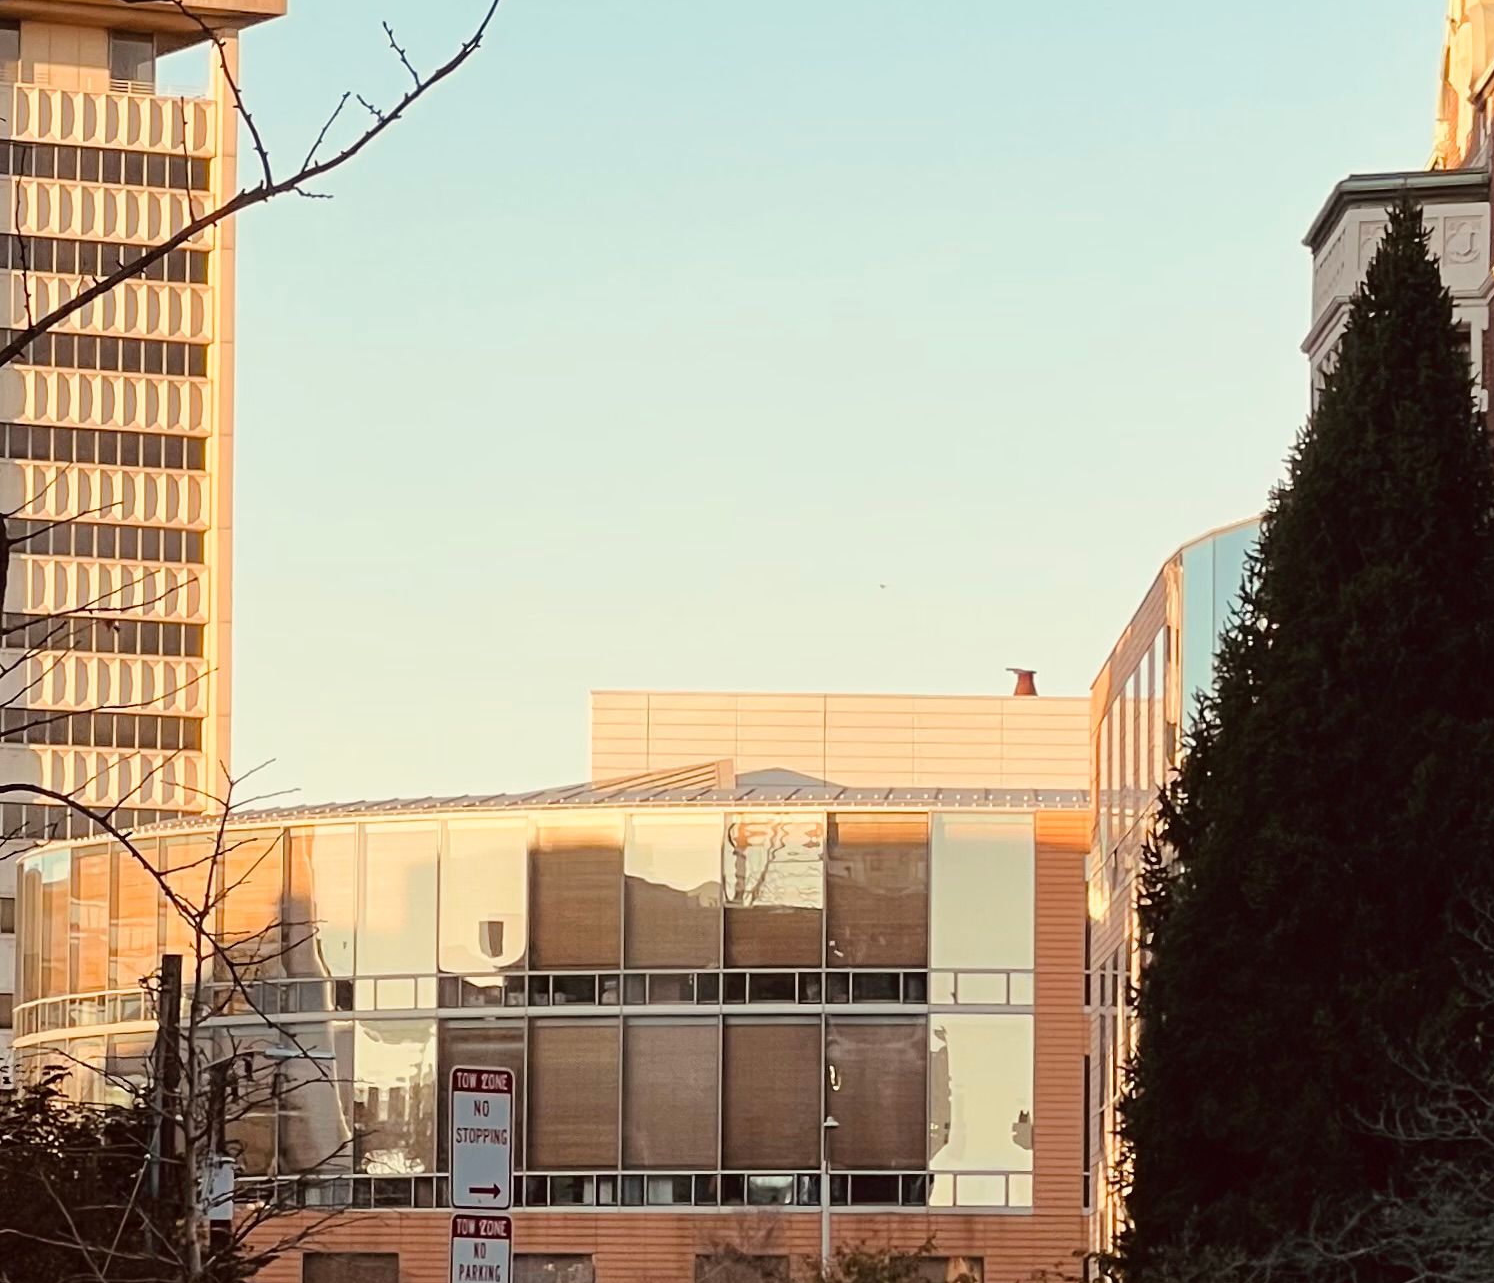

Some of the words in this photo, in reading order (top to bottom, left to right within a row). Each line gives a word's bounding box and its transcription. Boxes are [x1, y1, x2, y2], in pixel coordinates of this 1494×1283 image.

[456, 1072, 478, 1089] TOW
[481, 1073, 508, 1091] ZONE
[473, 1100, 490, 1117] NO
[456, 1128, 507, 1145] STOPPING
[456, 1218, 476, 1235] TOW
[479, 1219, 507, 1236] ZONE
[473, 1242, 486, 1259] NO
[459, 1264, 500, 1282] PARKING
